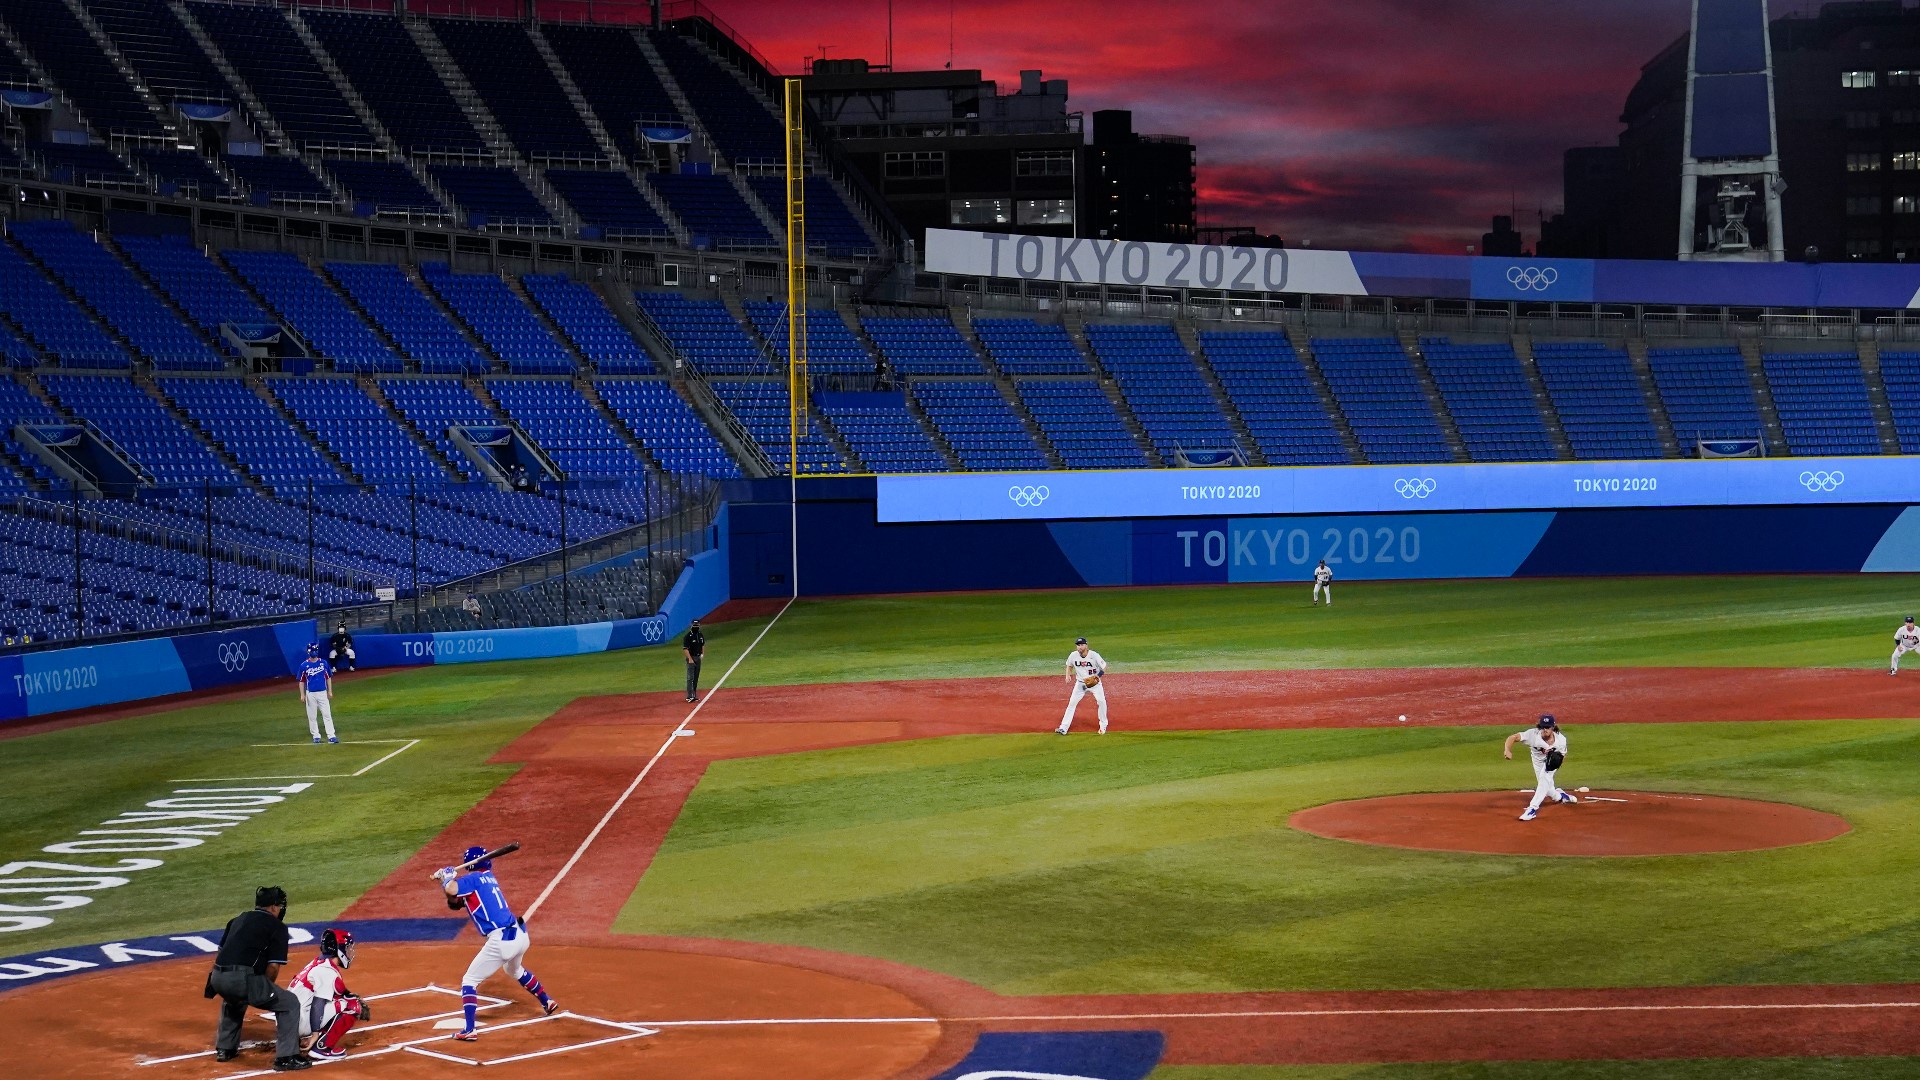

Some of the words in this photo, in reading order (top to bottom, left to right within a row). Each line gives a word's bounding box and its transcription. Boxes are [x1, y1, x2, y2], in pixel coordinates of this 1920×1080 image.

[983, 232, 1149, 284] TOKYO
[1165, 243, 1288, 291] 2020
[1181, 486, 1225, 499] TOKYO
[1228, 485, 1261, 499] 2020
[1574, 479, 1620, 492] TOKYO
[1623, 478, 1657, 491] 2020
[1177, 529, 1310, 568] TOKYO
[1322, 526, 1420, 564] 2020
[402, 639, 454, 657] TOKYO
[458, 637, 494, 655] 2020
[1074, 660, 1093, 668] USA
[13, 670, 62, 697] TOKYO
[63, 665, 98, 691] 2020
[41, 782, 315, 854] TOKYO
